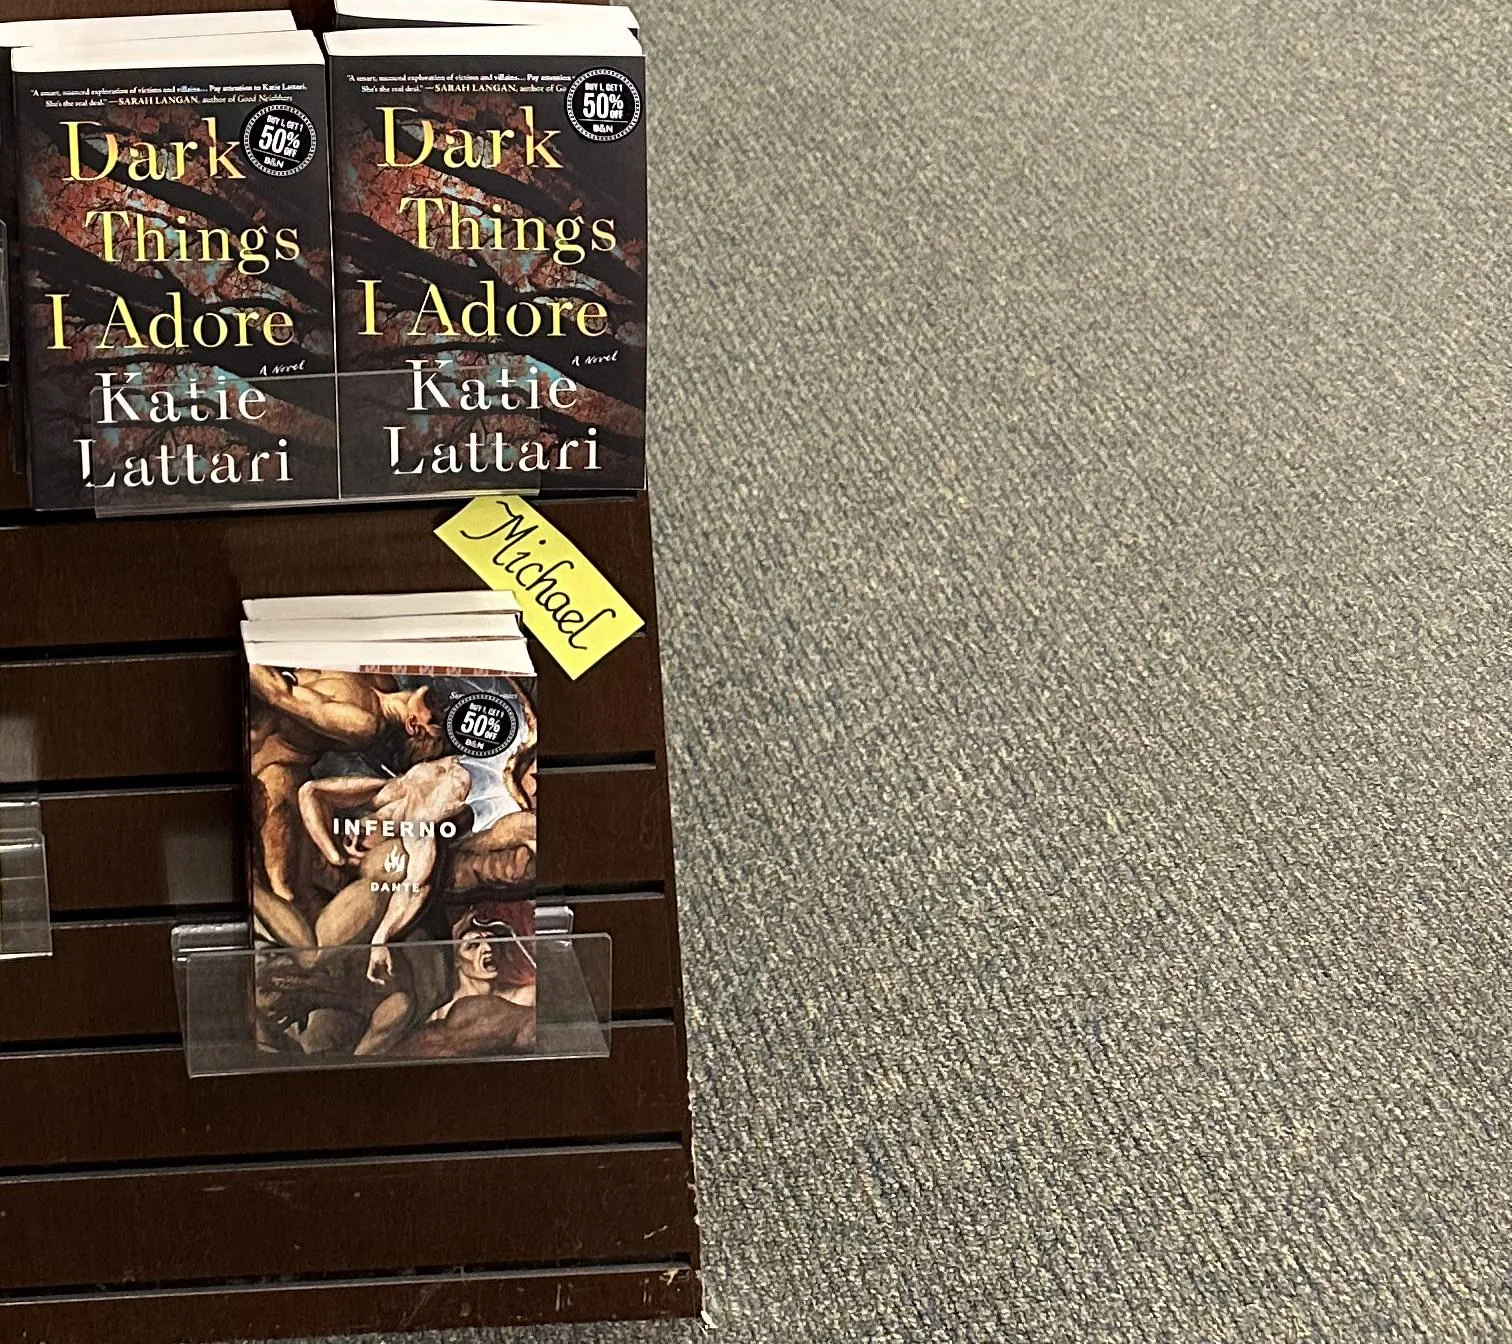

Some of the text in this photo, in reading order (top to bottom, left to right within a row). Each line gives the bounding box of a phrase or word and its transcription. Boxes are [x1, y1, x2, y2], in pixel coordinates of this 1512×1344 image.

[56, 116, 248, 184] Dark
[374, 105, 565, 170] Dark
[84, 208, 301, 277] Things
[398, 196, 618, 267] Things
[45, 290, 296, 351] I Adore
[356, 278, 609, 339] I Adore
[94, 370, 268, 426] Katie
[403, 358, 578, 412] Katie
[72, 436, 295, 489] Lattari
[383, 424, 604, 476] Lattari
[458, 499, 618, 654] Michael
[331, 816, 459, 839] INFERNO
[369, 881, 422, 894] DANTE
